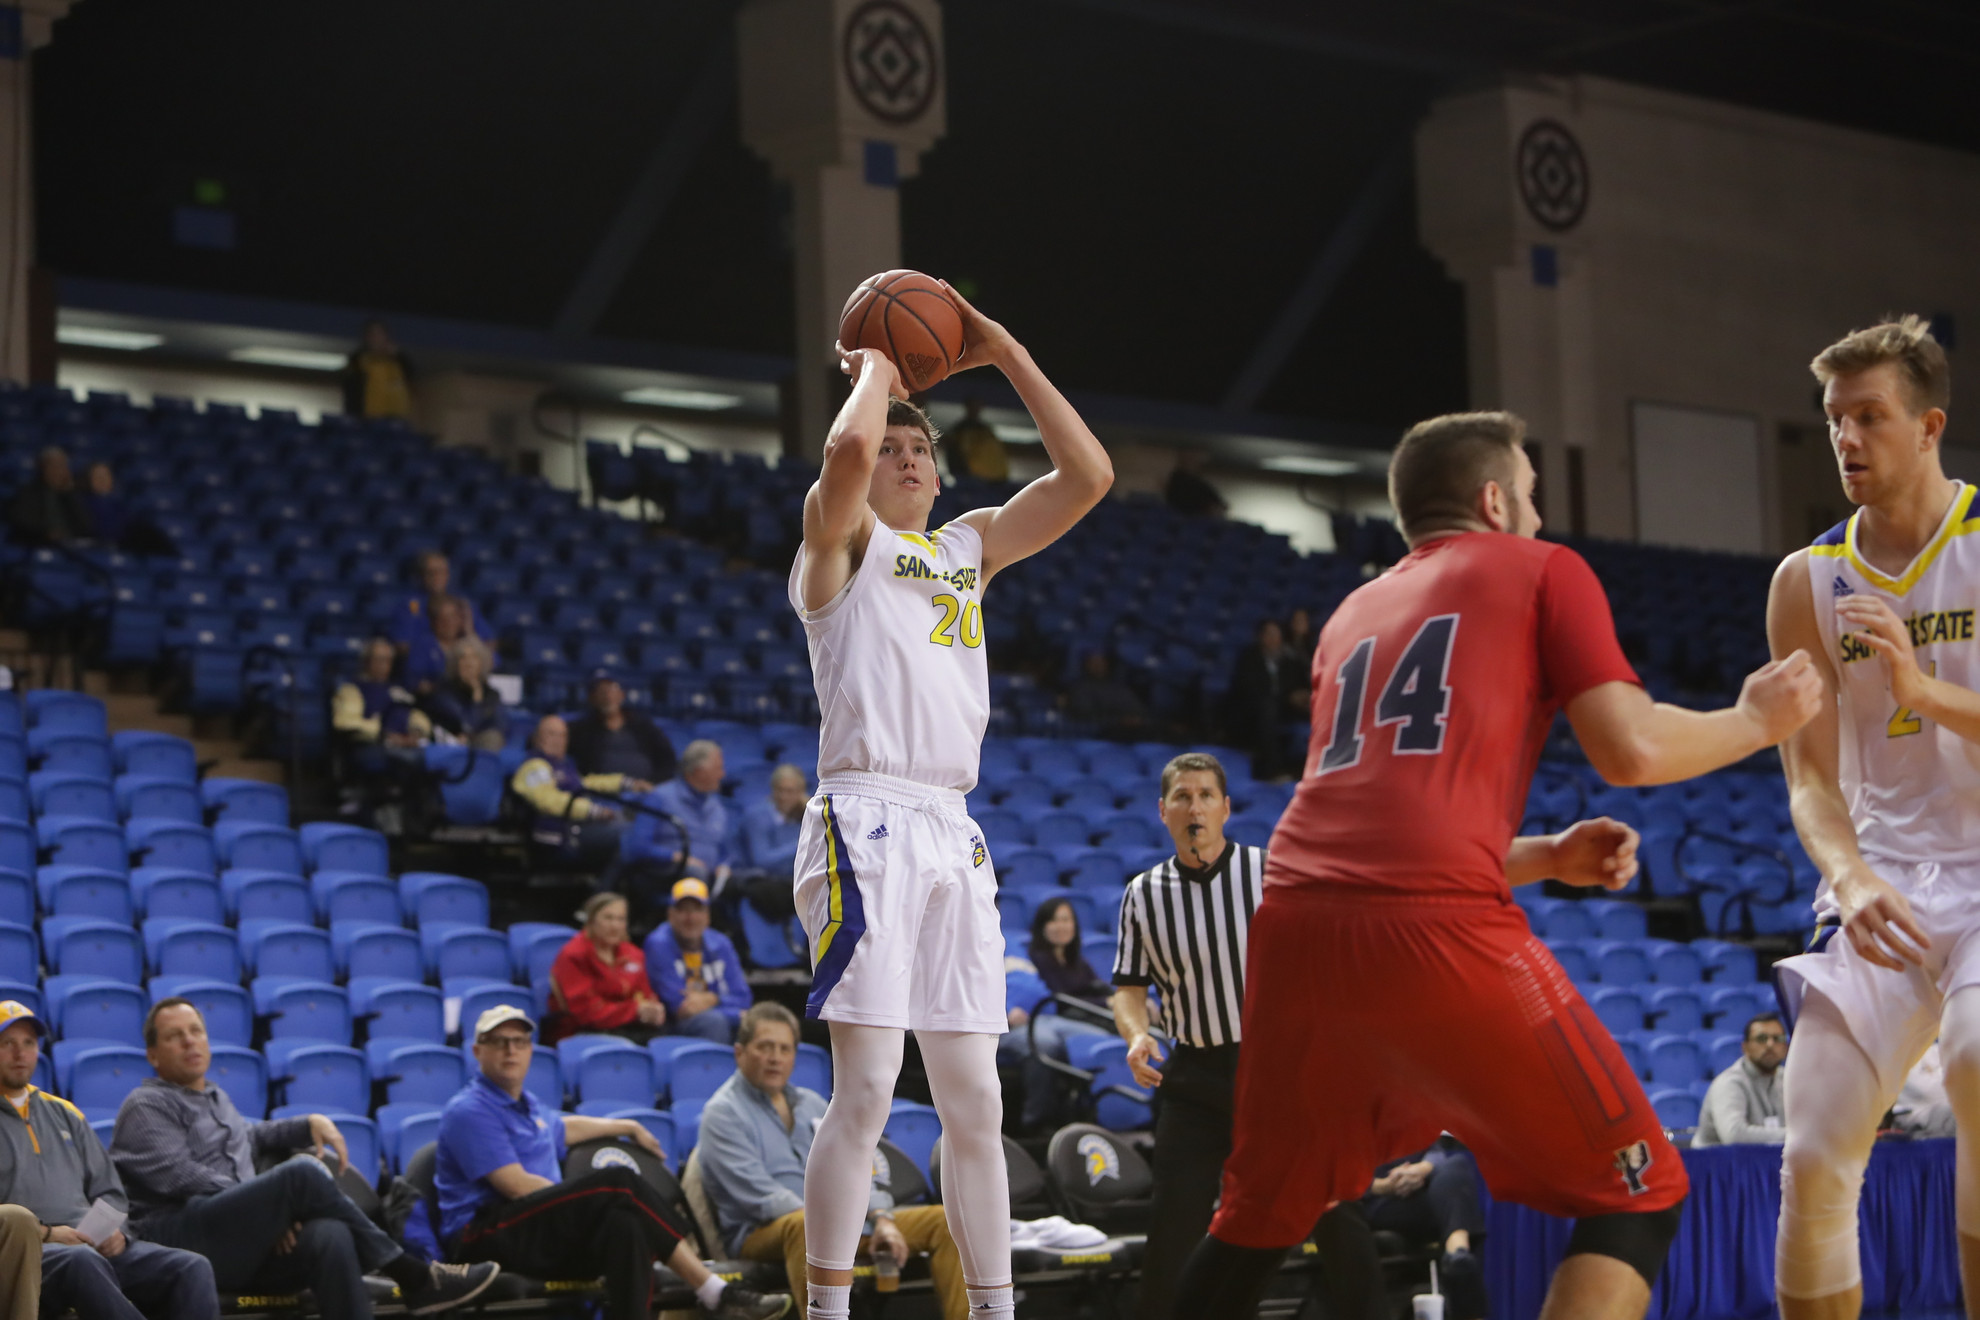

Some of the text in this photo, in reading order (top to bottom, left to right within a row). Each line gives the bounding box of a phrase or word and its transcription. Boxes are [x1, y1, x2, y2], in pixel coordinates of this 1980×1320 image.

[930, 593, 982, 648] 20
[1919, 611, 1975, 645] STATE
[1316, 613, 1461, 777] 14
